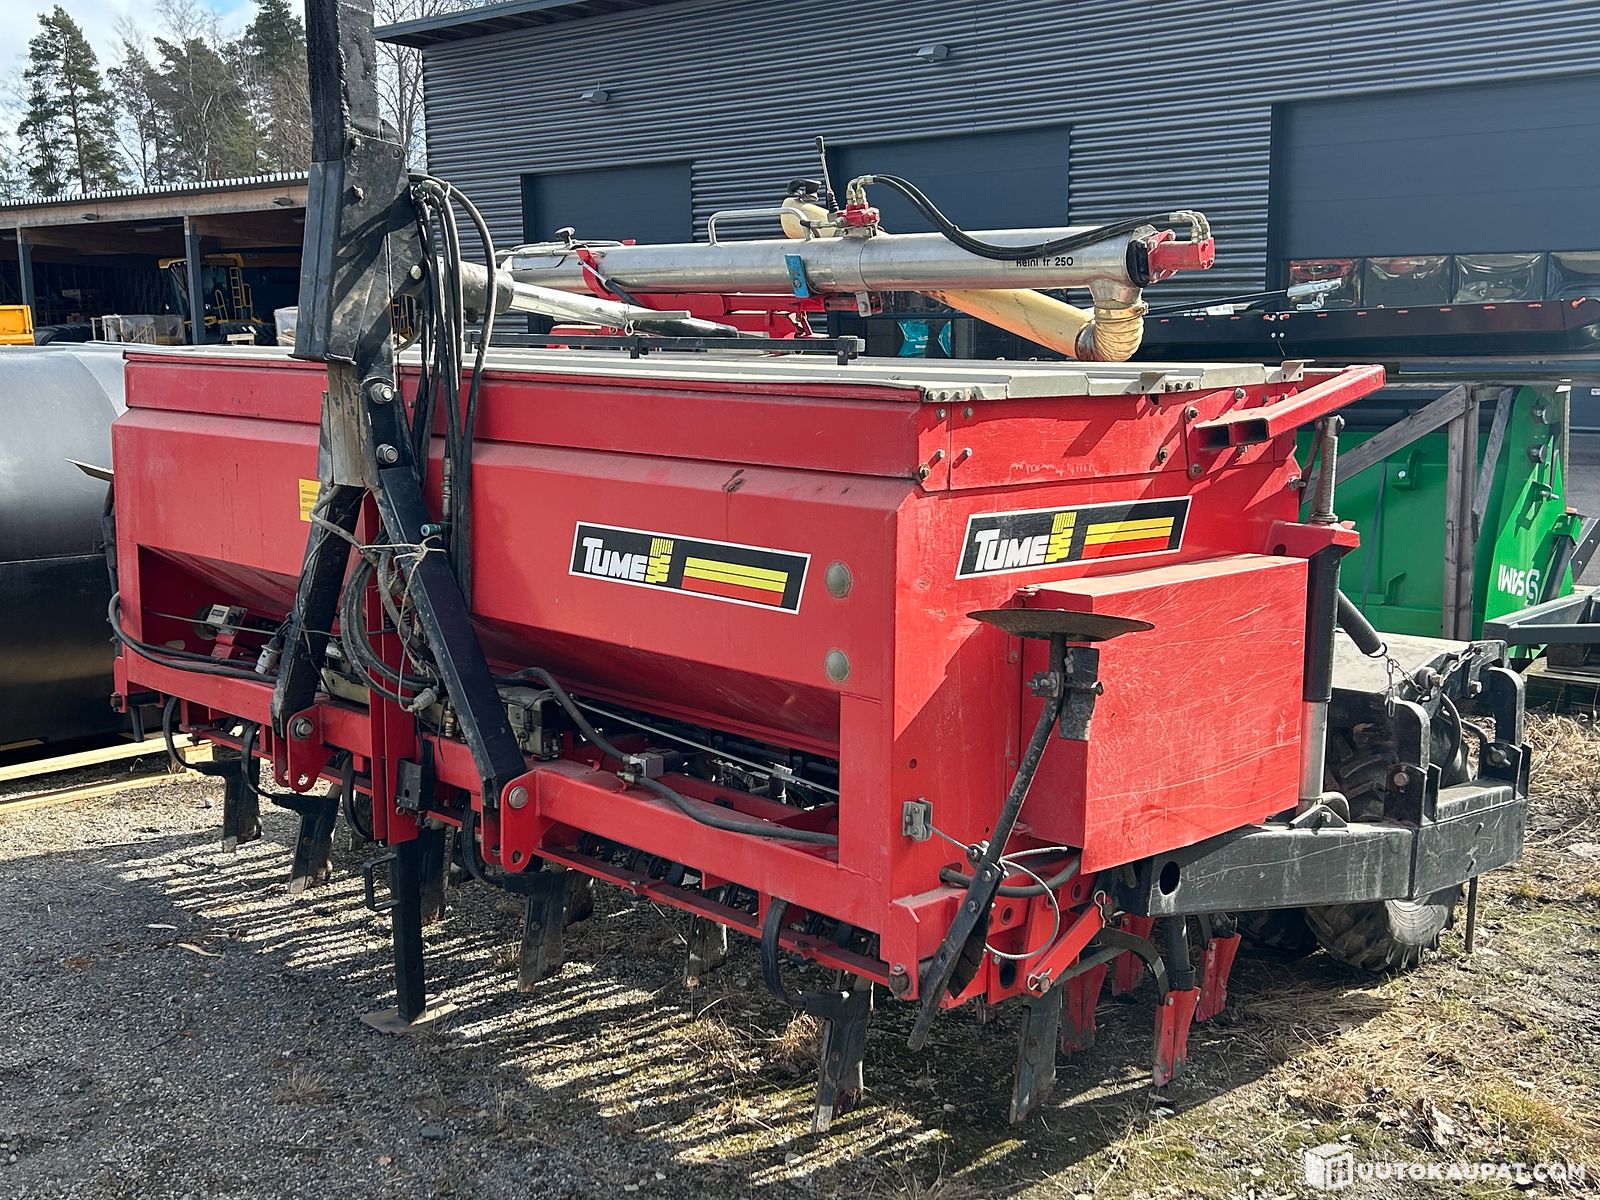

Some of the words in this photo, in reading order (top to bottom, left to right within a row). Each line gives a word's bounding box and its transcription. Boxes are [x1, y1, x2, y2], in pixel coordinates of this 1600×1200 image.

[1055, 257, 1074, 266] 250
[583, 537, 648, 581] TUME
[975, 528, 1049, 571] TUME
